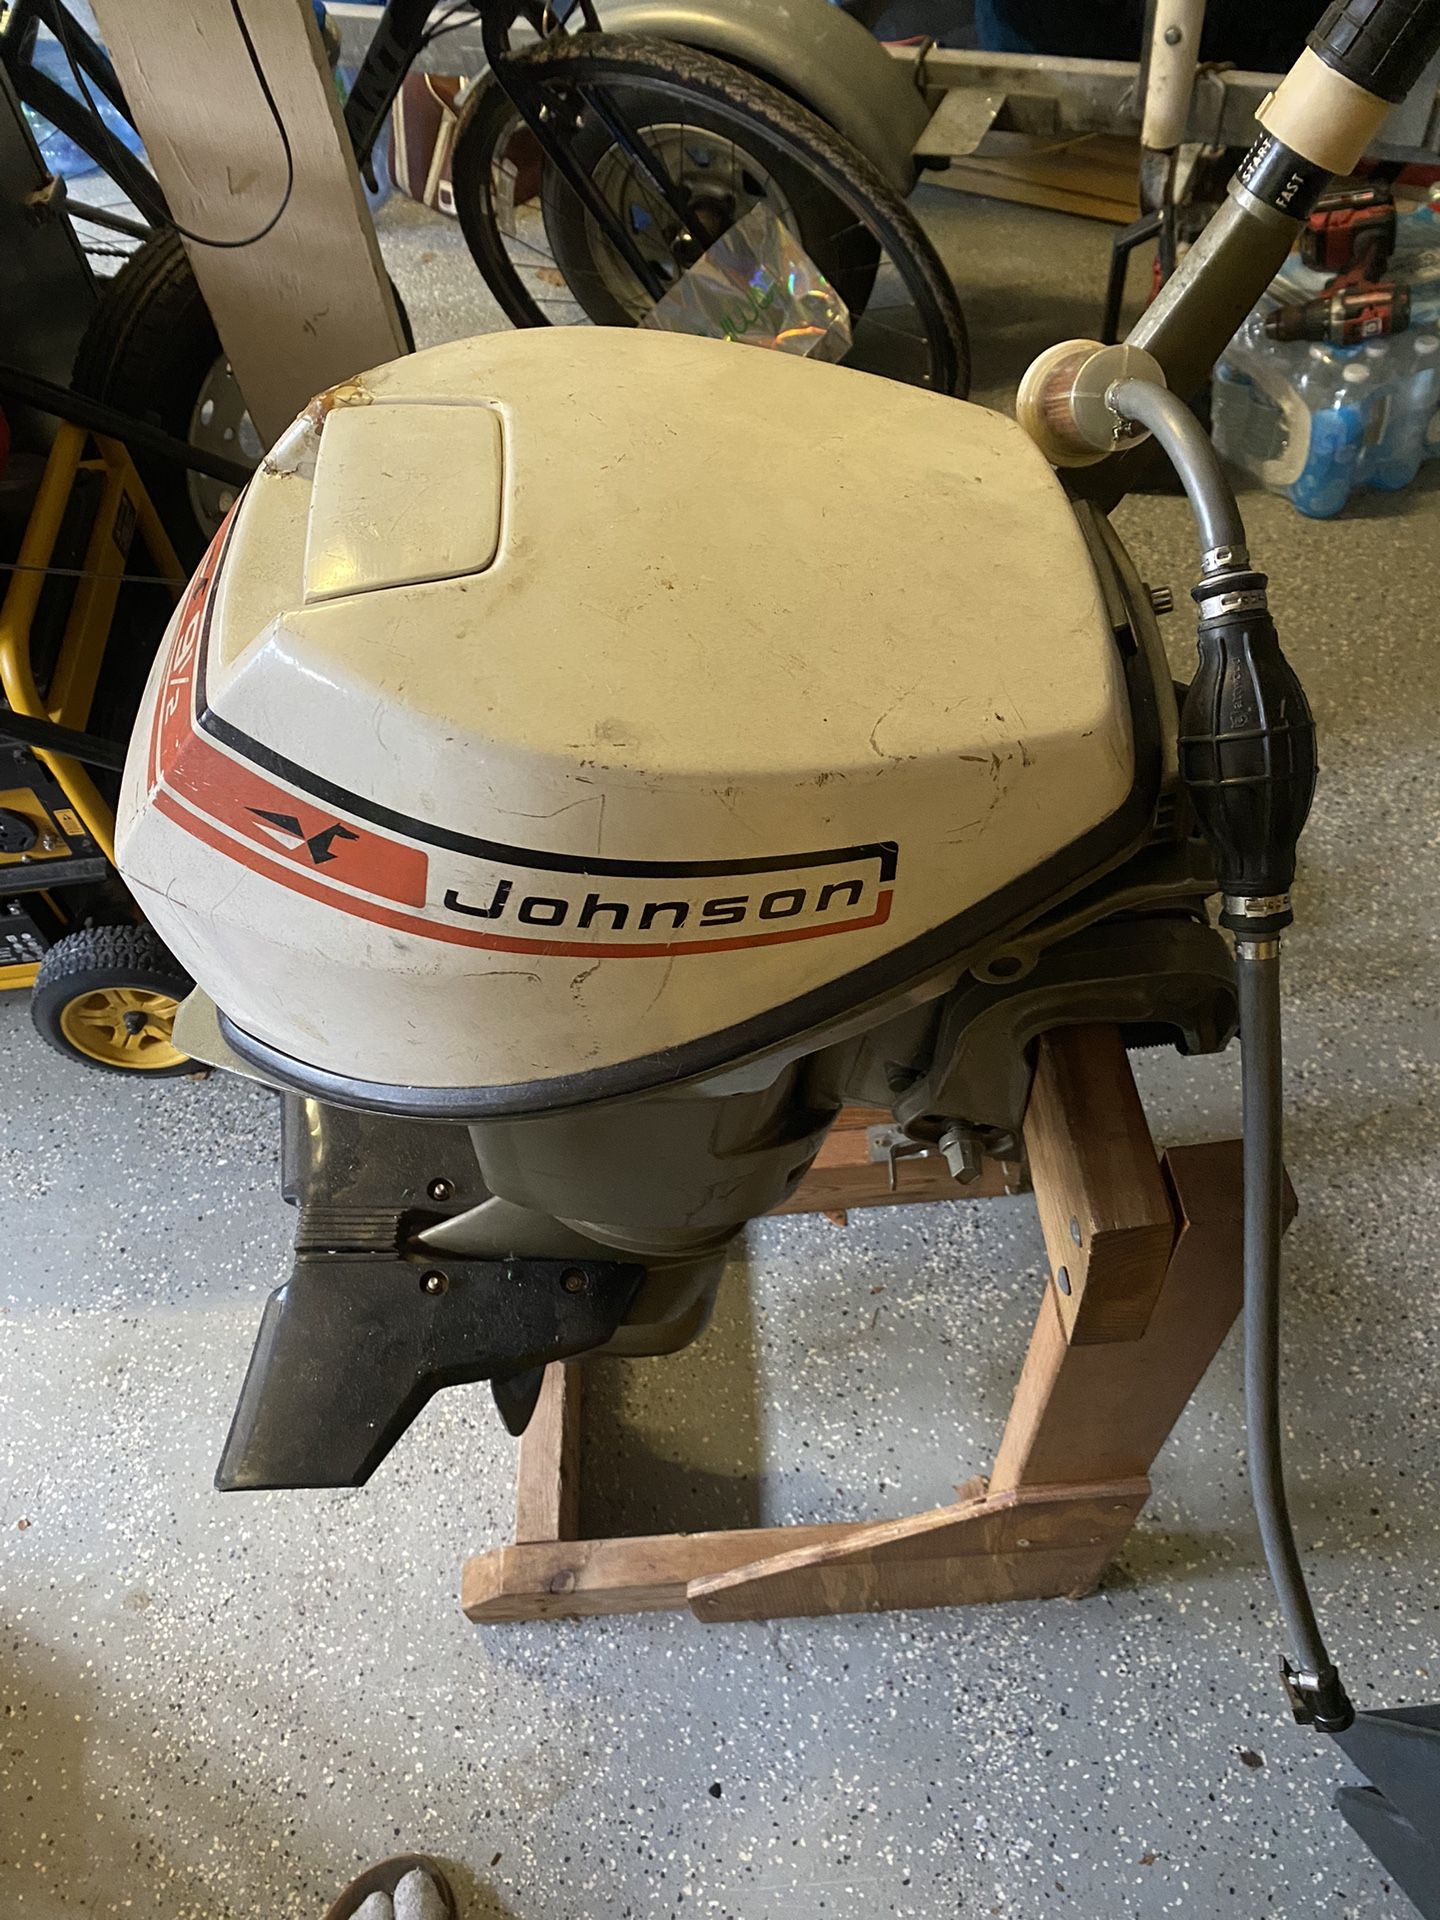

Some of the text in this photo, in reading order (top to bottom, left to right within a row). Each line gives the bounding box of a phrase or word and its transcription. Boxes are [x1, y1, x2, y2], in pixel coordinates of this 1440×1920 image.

[1242, 138, 1272, 183] START
[1276, 173, 1304, 207] FAST
[444, 879, 863, 929] Johnson
